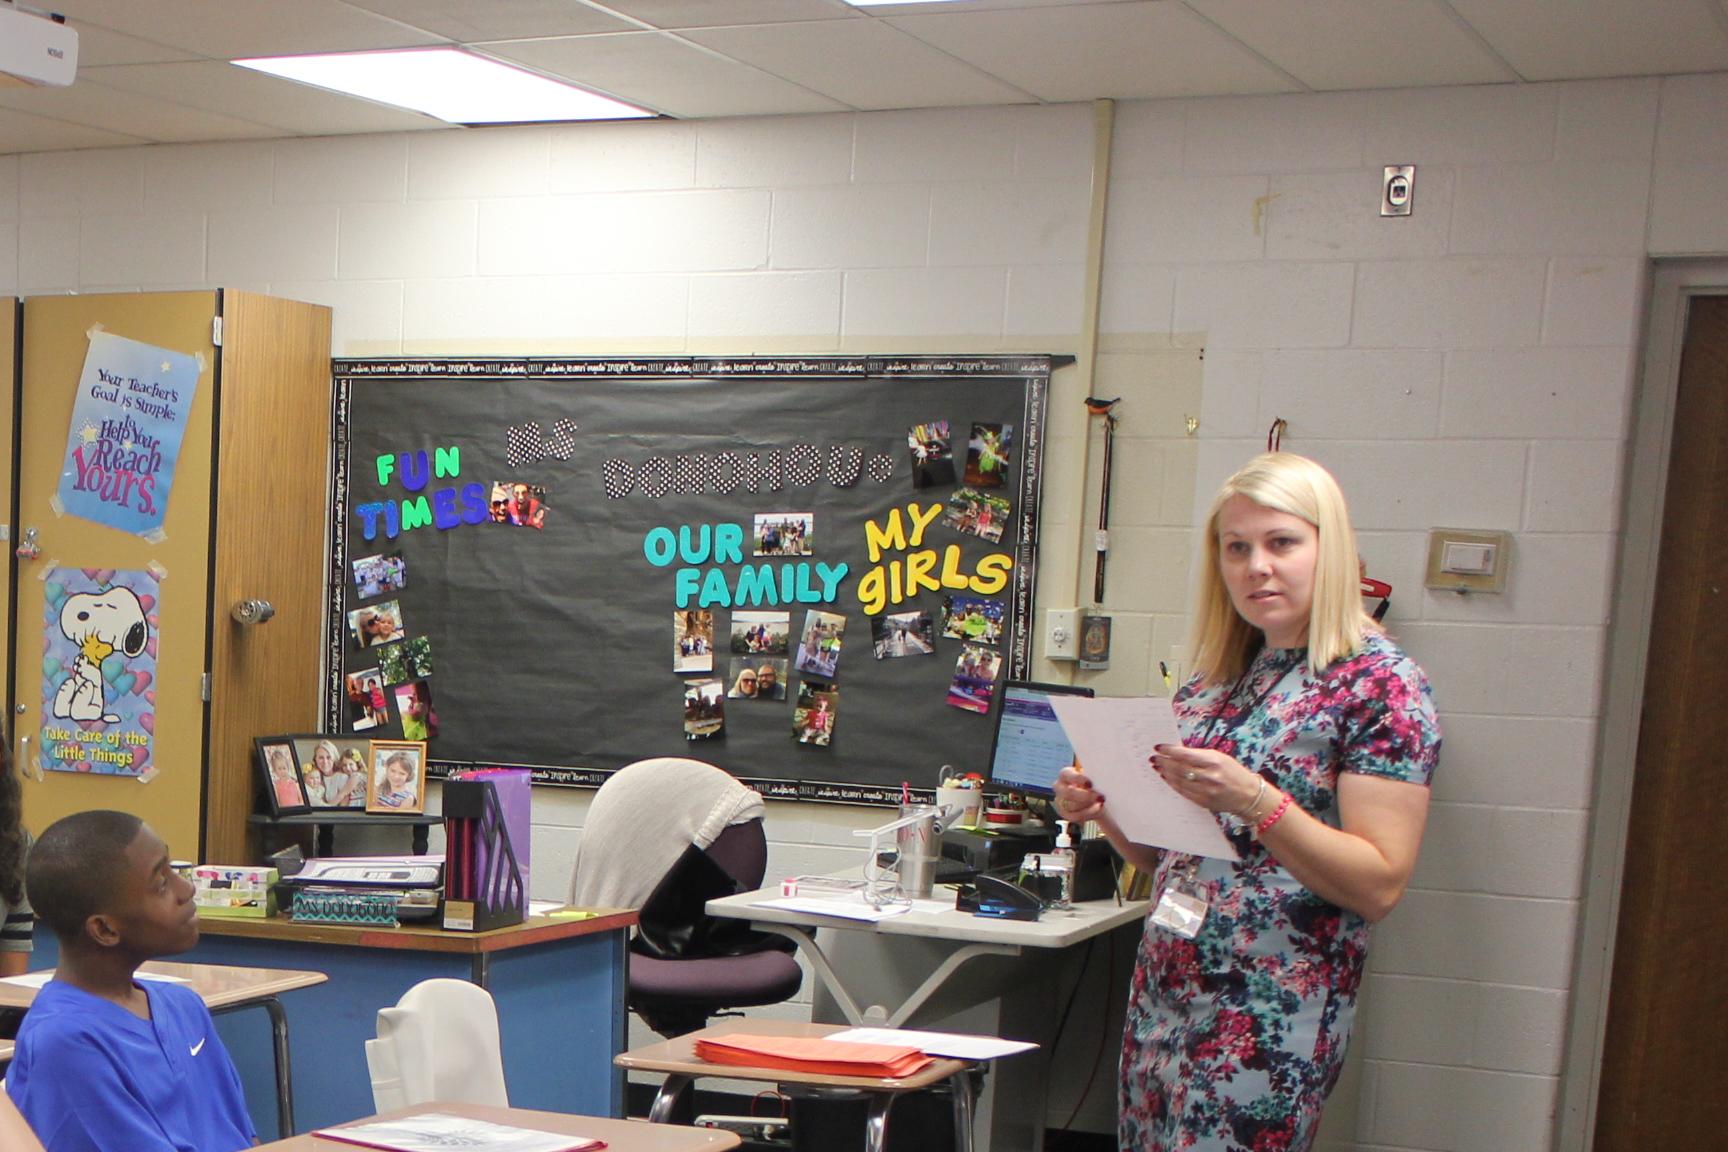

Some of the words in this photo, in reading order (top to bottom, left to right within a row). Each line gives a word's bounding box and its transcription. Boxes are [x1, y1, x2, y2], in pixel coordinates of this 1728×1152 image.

[91, 385, 120, 403] Goal
[121, 393, 133, 408] is
[98, 368, 123, 387] Your
[128, 378, 179, 403] Teacher's
[98, 418, 131, 446] Help
[124, 414, 136, 429] to
[92, 438, 162, 475] Reach
[376, 446, 461, 492] FUN
[72, 444, 157, 517] Yours.
[355, 482, 490, 542] TIMES
[643, 522, 745, 568] OUR
[864, 502, 943, 564] MY
[674, 562, 849, 610] FAMILY
[44, 726, 71, 741] Take
[74, 729, 103, 743] Care
[107, 730, 121, 748] of
[125, 731, 148, 746] the
[54, 745, 86, 761] Little
[89, 747, 134, 768] Things
